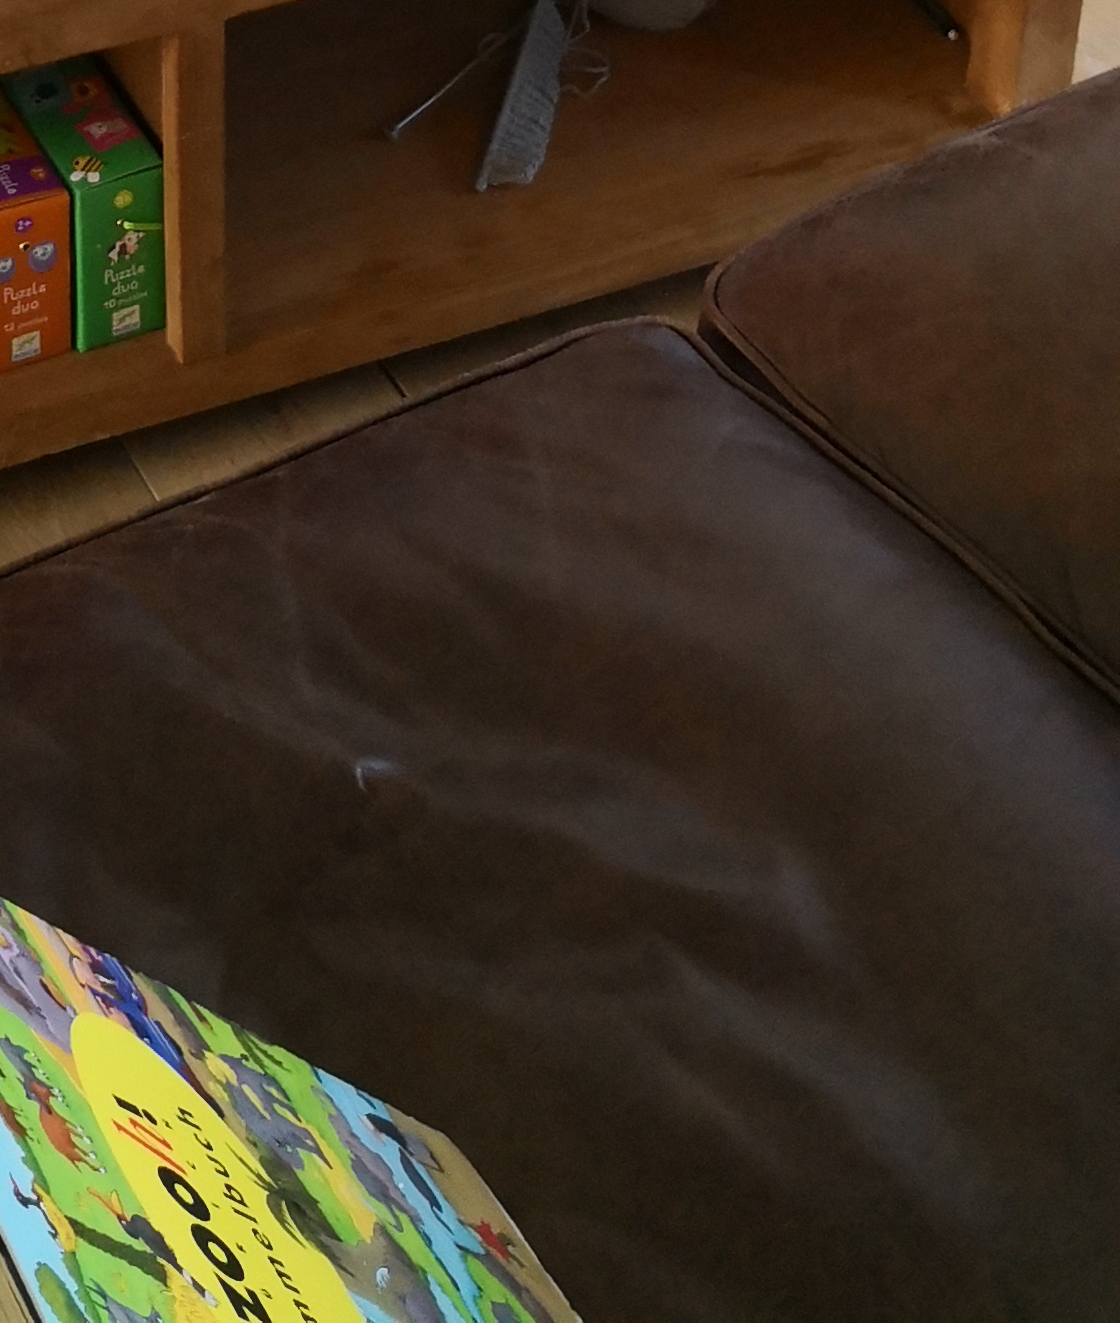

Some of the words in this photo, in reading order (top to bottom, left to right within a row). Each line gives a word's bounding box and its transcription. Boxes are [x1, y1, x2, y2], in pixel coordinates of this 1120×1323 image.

[103, 263, 146, 285] Puzzle
[2, 281, 48, 304] Puzzle
[111, 279, 139, 297] duo
[11, 299, 40, 316] duo
